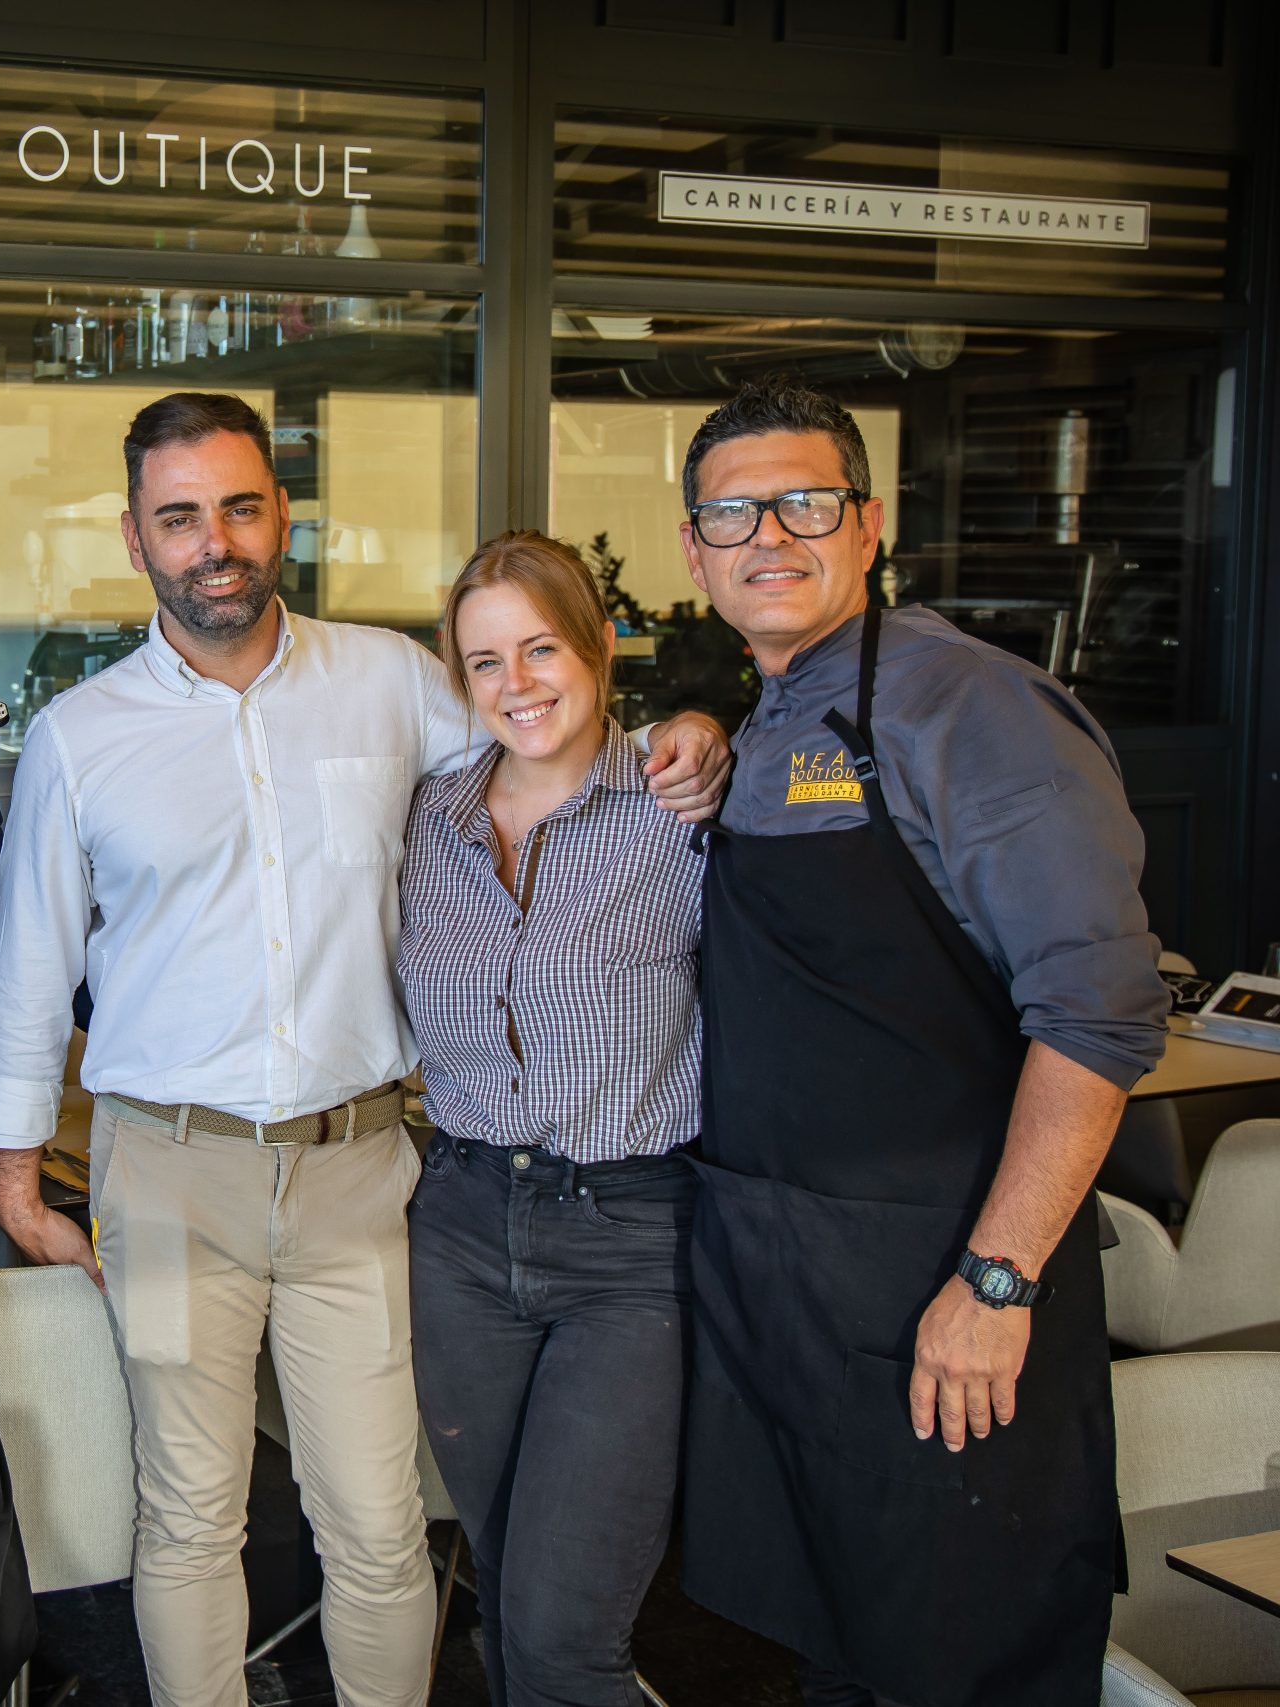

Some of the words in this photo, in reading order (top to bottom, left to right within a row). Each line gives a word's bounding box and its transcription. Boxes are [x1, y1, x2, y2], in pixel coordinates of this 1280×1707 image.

[684, 188, 871, 218] CARNICERÍA
[890, 201, 903, 219] Y
[923, 204, 1127, 232] RESTAURANTE
[791, 749, 845, 770] MEA
[789, 767, 856, 784] BOUTIQU
